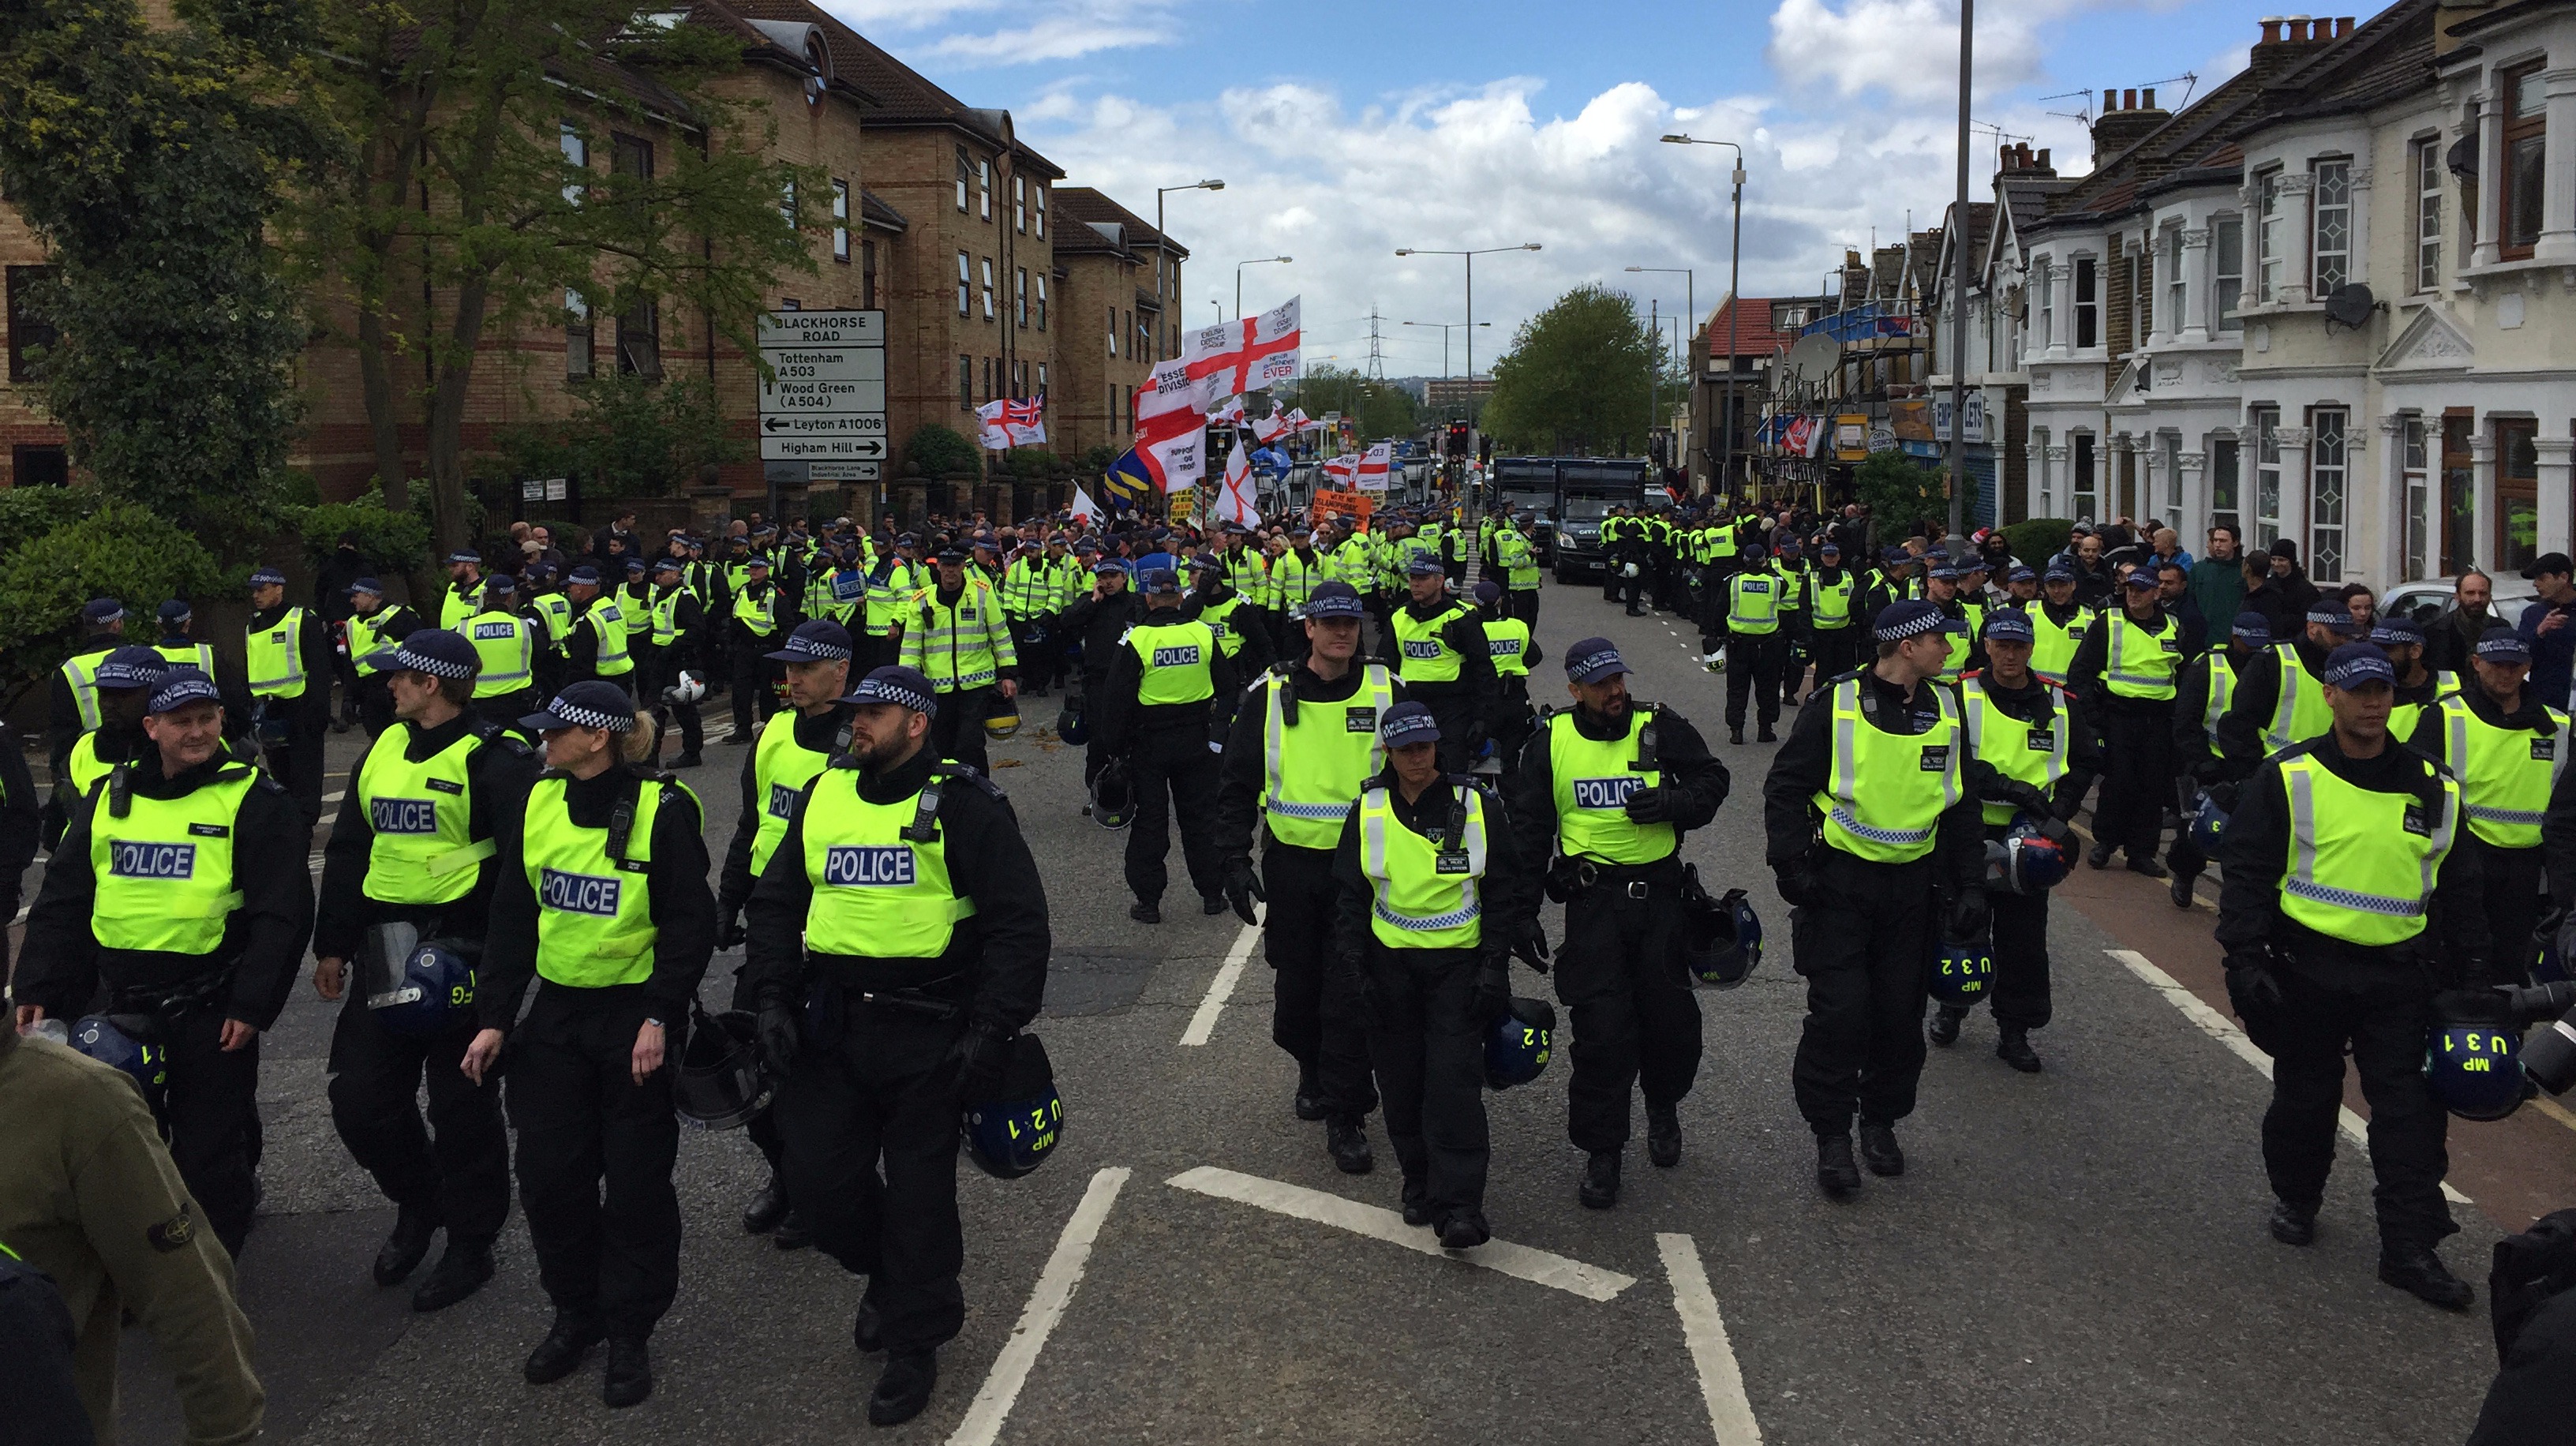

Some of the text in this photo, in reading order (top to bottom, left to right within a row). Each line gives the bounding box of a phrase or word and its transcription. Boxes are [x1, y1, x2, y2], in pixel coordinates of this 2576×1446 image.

[775, 317, 866, 328] BLACKHORSE
[803, 332, 840, 341] ROAD
[779, 353, 843, 363] Tottenham
[1161, 368, 1185, 383] ESSE
[1264, 366, 1292, 378] EVER
[780, 383, 855, 393] Wood Green
[1158, 377, 1191, 395] DIVISIO
[794, 418, 881, 431] Leyton A1006
[781, 443, 853, 455] Higham Hill
[1743, 582, 1768, 591] POLICE
[476, 624, 513, 637] POLICE
[1406, 642, 1439, 657] POLICE
[1489, 640, 1519, 654] POLICE
[1155, 647, 1198, 665] POLICE
[372, 801, 433, 830] POLICE
[113, 845, 189, 876] POLICE
[828, 851, 912, 882] POLICE
[542, 872, 616, 912] POLICE
[1961, 980, 1981, 991] MP
[2463, 1058, 2490, 1072] MP
[1032, 1129, 1054, 1152] MP
